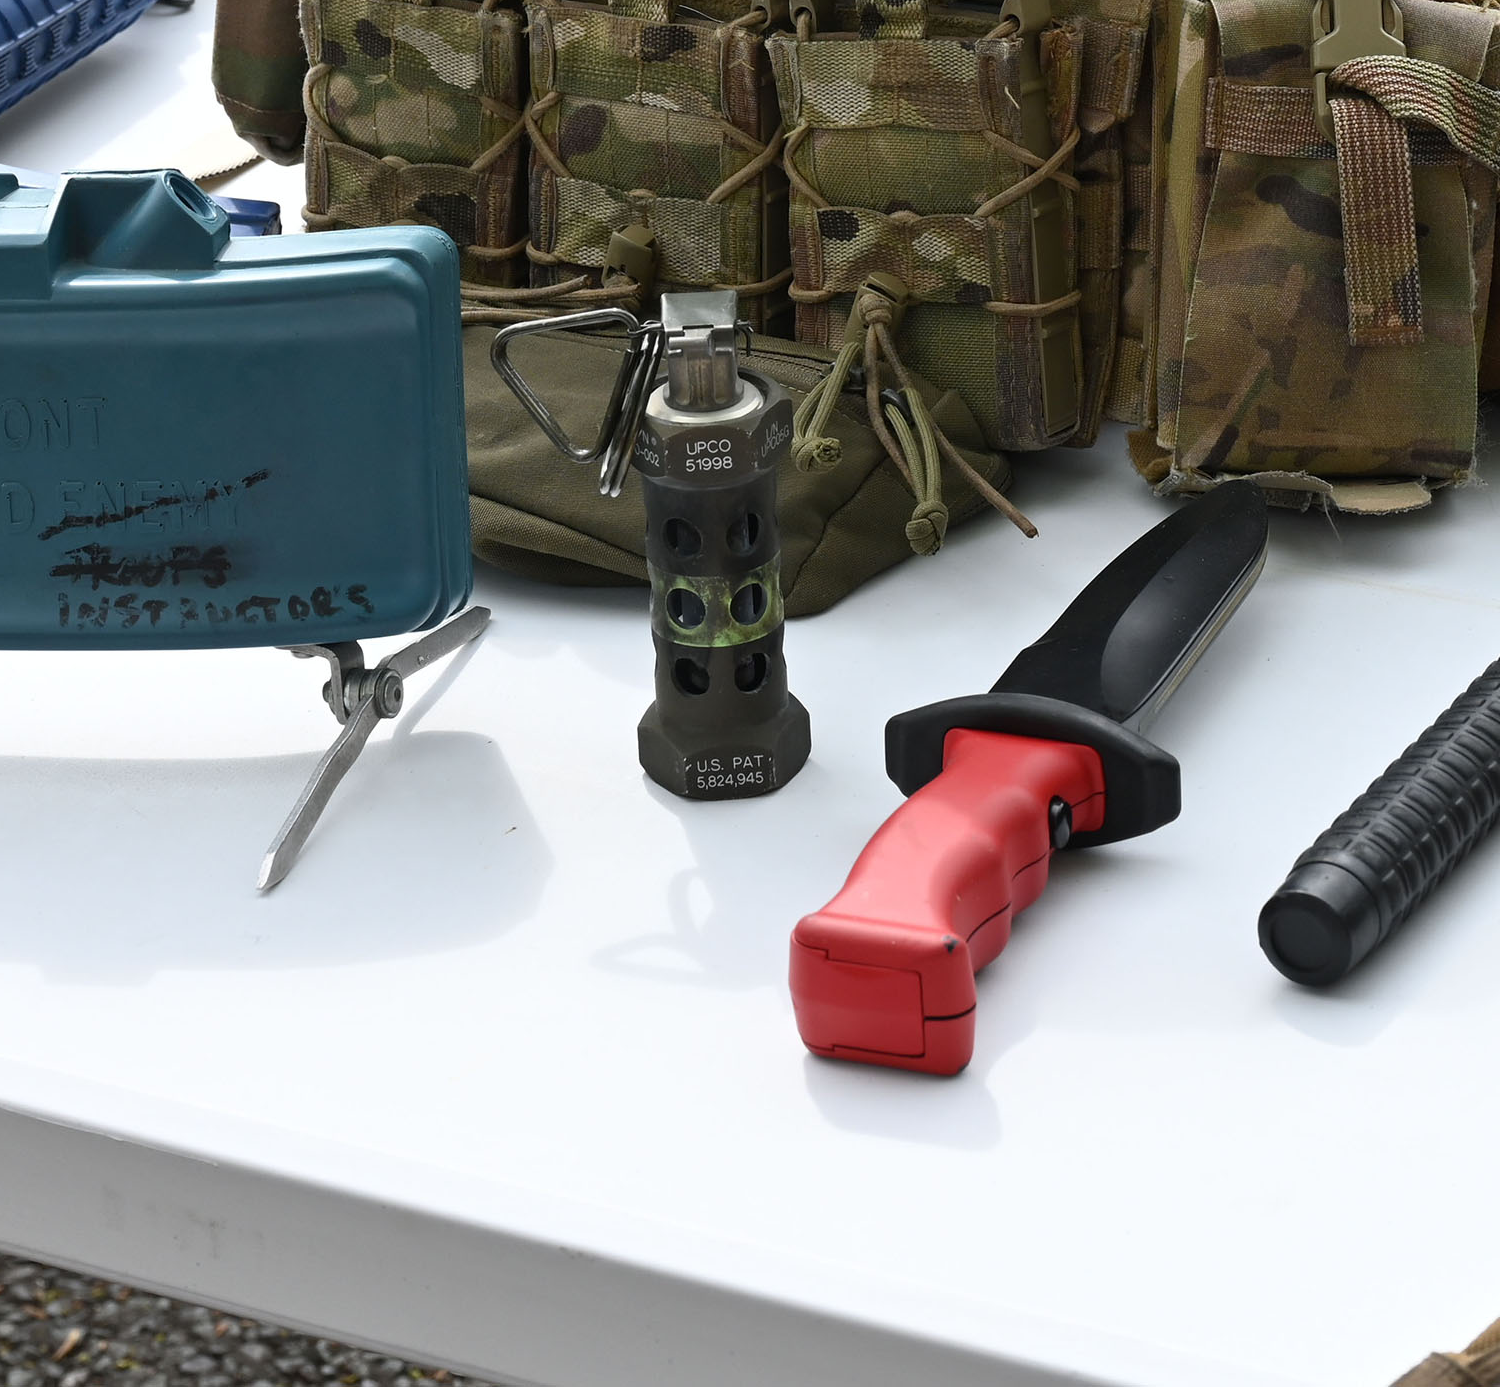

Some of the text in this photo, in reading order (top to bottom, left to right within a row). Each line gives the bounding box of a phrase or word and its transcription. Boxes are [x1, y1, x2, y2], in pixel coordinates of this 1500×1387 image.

[685, 438, 732, 456] UPCO
[685, 455, 734, 473] 51998
[57, 476, 250, 534] ENEMY
[696, 754, 764, 773] U.S. PAT
[696, 771, 764, 790] 5,824,945
